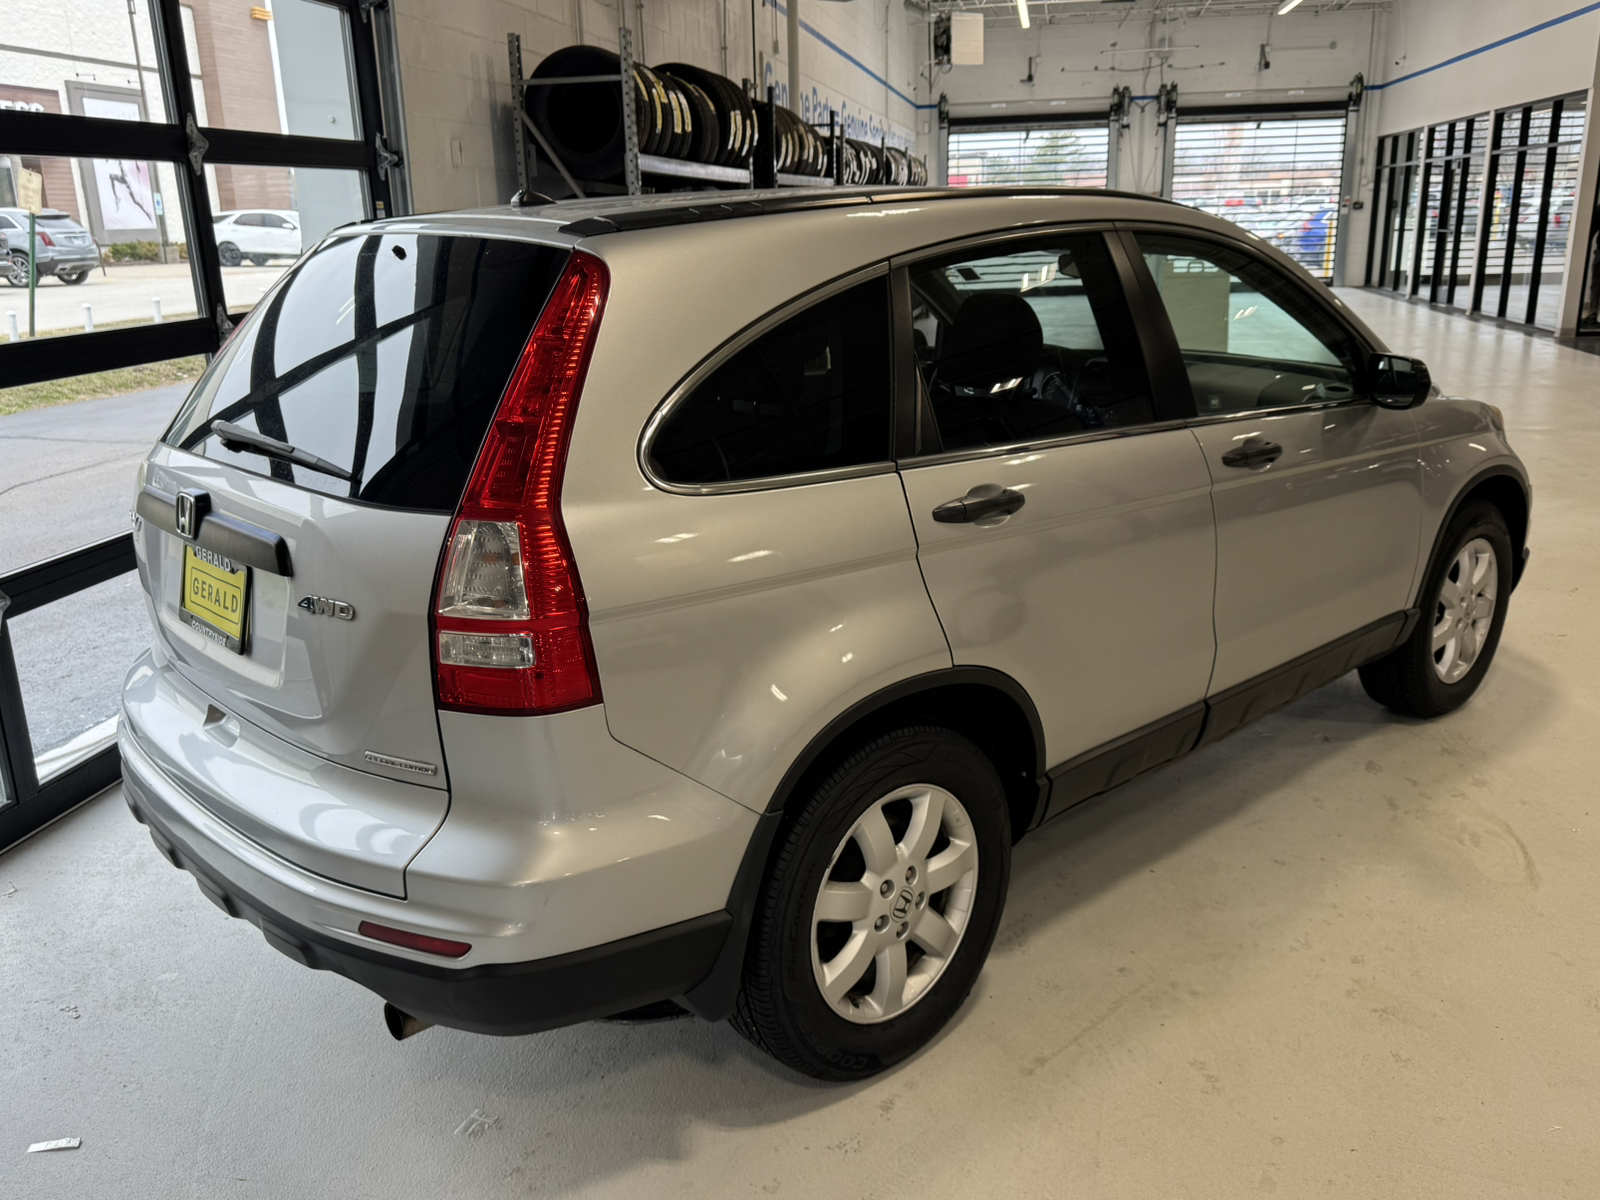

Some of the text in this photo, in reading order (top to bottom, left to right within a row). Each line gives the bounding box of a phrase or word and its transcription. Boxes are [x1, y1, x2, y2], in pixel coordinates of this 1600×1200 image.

[195, 545, 231, 573] GERALD
[192, 577, 239, 614] GERALD
[298, 595, 355, 620] 4WD
